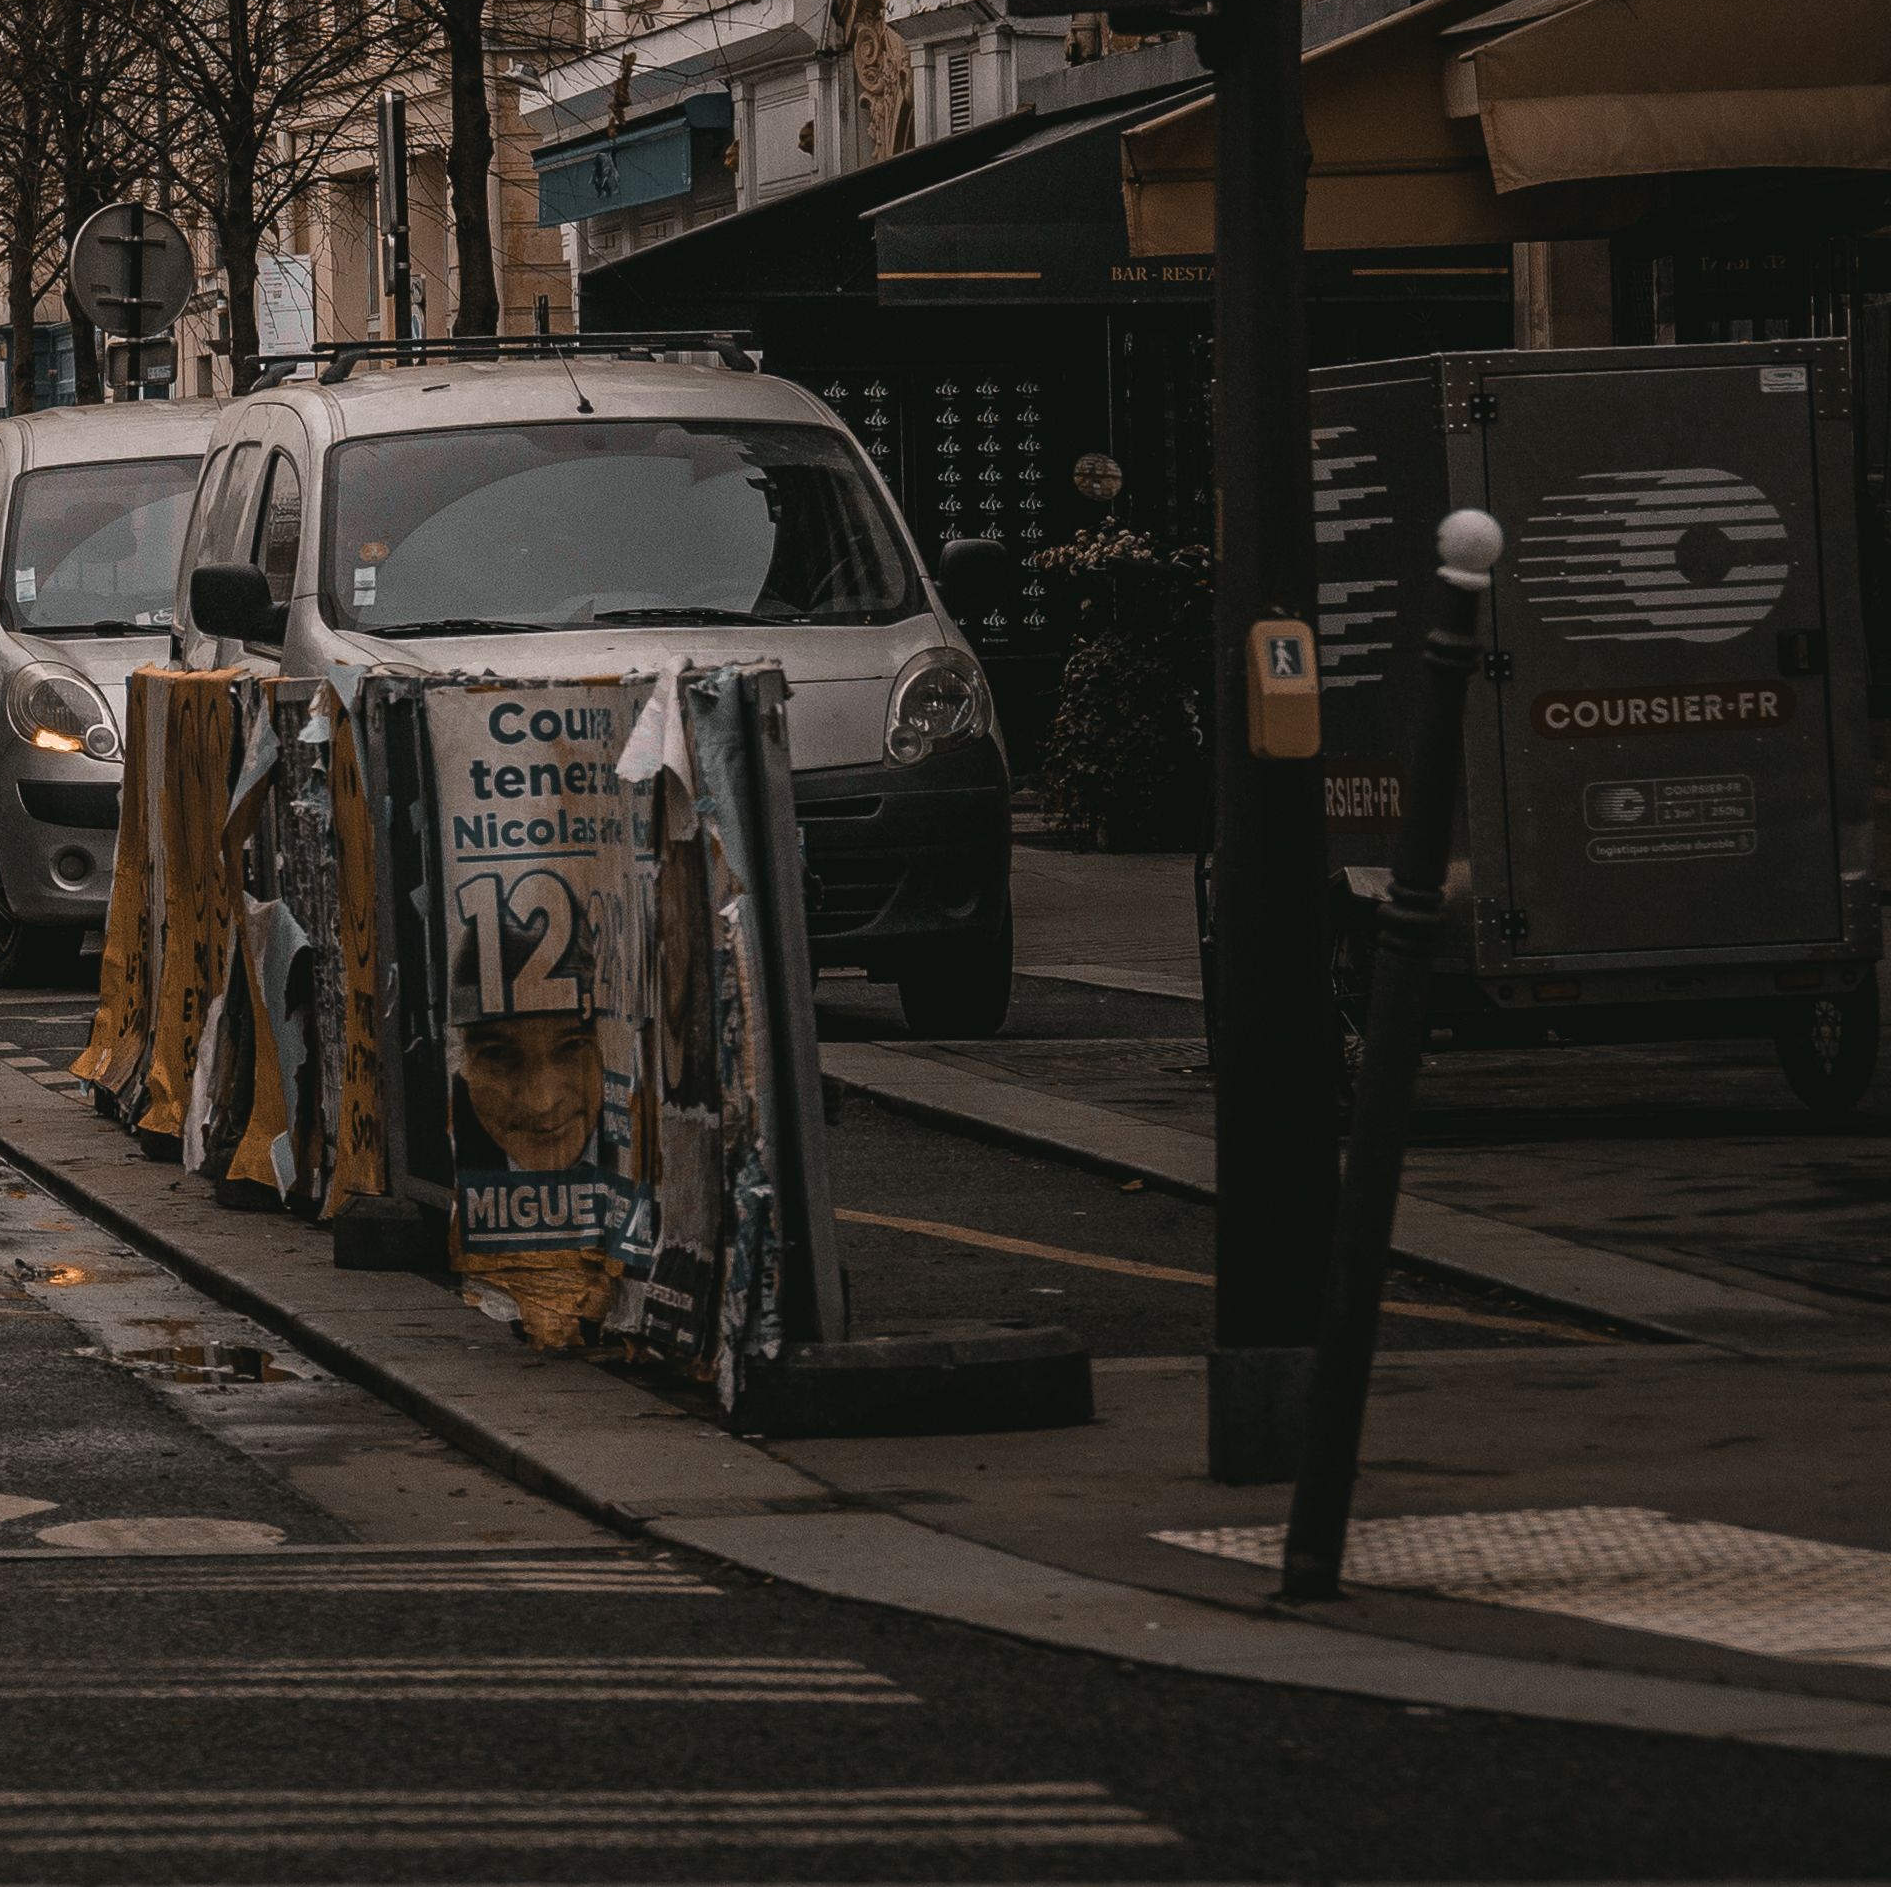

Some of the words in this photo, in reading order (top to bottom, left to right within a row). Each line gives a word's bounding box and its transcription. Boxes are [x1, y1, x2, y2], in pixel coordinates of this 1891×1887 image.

[1110, 265, 1148, 281] BAR
[823, 381, 850, 399] else
[863, 380, 890, 398] else
[935, 378, 961, 396] else
[975, 377, 1001, 395] else
[1016, 377, 1042, 395] else
[864, 409, 891, 427] else
[935, 407, 961, 425] else
[977, 406, 1002, 424] else
[1017, 405, 1042, 423] else
[936, 436, 963, 454] else
[978, 435, 1003, 453] else
[1018, 434, 1043, 452] else
[937, 465, 963, 483] else
[979, 464, 1004, 482] else
[1019, 463, 1044, 481] else
[938, 494, 964, 512] else
[979, 493, 1005, 511] else
[1020, 492, 1045, 510] else
[1022, 579, 1047, 596] else
[983, 609, 1009, 627] else
[1023, 609, 1049, 627] else
[453, 809, 597, 850] Nicolas
[1595, 843, 1651, 858] logistique
[1651, 842, 1693, 854] urbaine
[1694, 839, 1736, 851] durable
